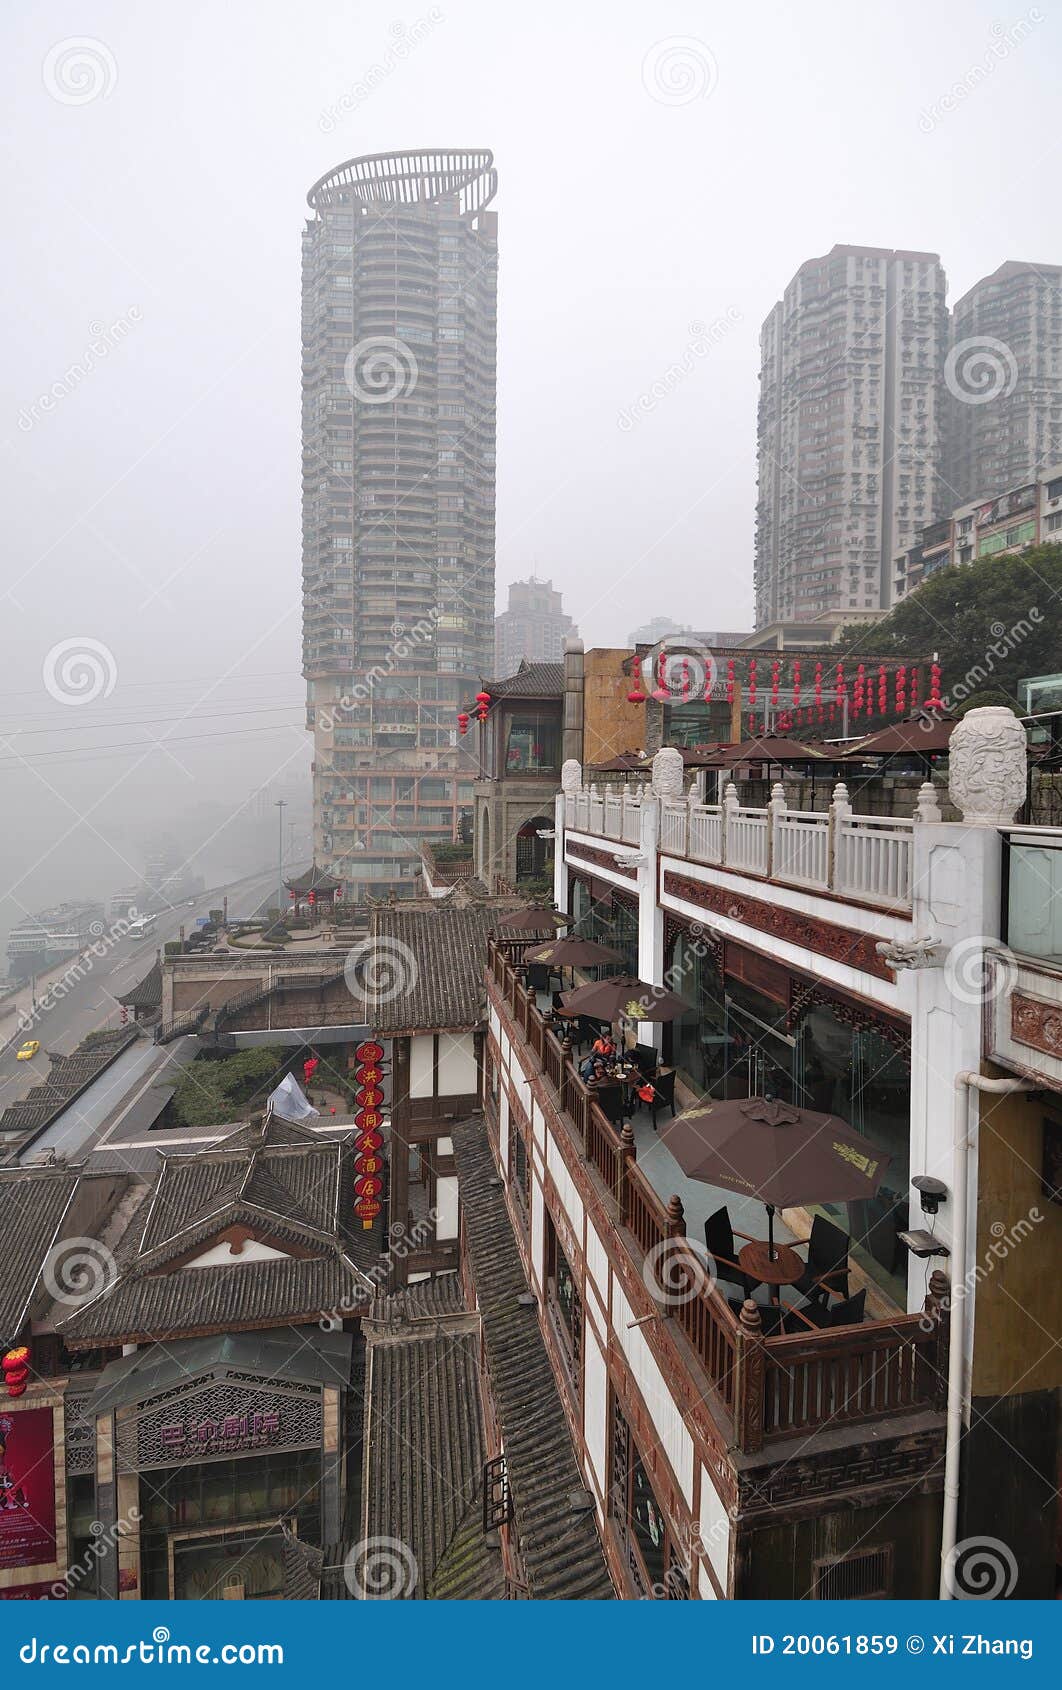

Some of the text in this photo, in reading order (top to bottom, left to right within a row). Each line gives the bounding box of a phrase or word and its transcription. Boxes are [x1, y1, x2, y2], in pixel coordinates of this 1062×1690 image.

[361, 1070, 377, 1195] 洪崖洞大酒店
[161, 1411, 279, 1445] 巴渝剧院
